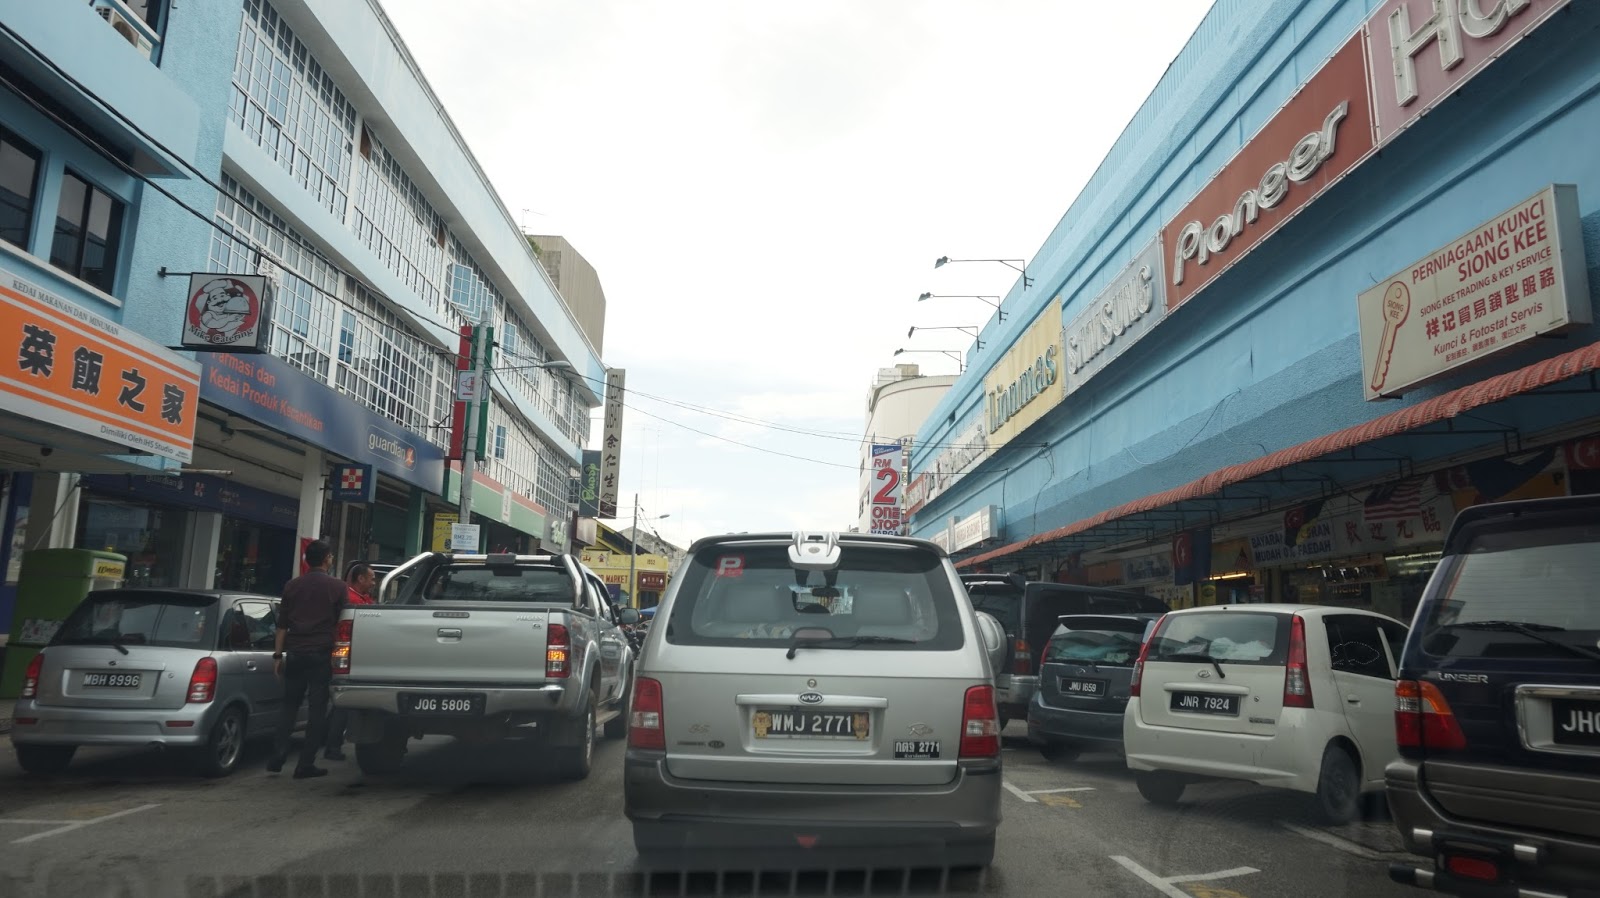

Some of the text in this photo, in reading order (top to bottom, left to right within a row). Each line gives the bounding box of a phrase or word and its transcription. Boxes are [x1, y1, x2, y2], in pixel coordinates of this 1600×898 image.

[1174, 99, 1349, 286] Pioneer
[1412, 199, 1545, 284] PERNIAGAAN KUNCI
[1458, 220, 1547, 282] SIONG KEE
[1420, 246, 1552, 318] SIONG KEE TRADING & KEY SERVICE
[12, 279, 119, 336] KEDAI MAKANAN DAN MINUMAN
[1387, 299, 1404, 313] SIONG
[1390, 310, 1400, 320] KEE
[1069, 265, 1153, 376] SAMSUNG
[1434, 302, 1544, 356] Kunci & Fotostat Servis
[188, 324, 254, 344] Mike Catering
[18, 323, 186, 425] 菜飯之家
[256, 368, 276, 388] dan
[208, 366, 324, 433] Kedai Produk Kecantikan
[100, 425, 128, 442] Dimiliki
[127, 432, 143, 445] Oleh
[154, 440, 174, 454] Studio
[368, 432, 406, 461] guardian
[873, 458, 892, 468] RM
[872, 467, 901, 505] 2
[870, 519, 900, 531] STOP
[1255, 548, 1281, 562] MUDAH
[1297, 541, 1332, 556] FAEDAH
[719, 556, 742, 574] P
[605, 574, 628, 584] MARKET
[108, 673, 140, 687] 8996
[1068, 682, 1097, 692] JMU 1659
[1438, 672, 1489, 684] UNSER
[414, 699, 471, 711] JQG 5806
[800, 694, 822, 702] NAZA
[1180, 696, 1230, 710] JNR 7924
[771, 713, 852, 734] WMJ 2771
[919, 742, 940, 753] 2771
